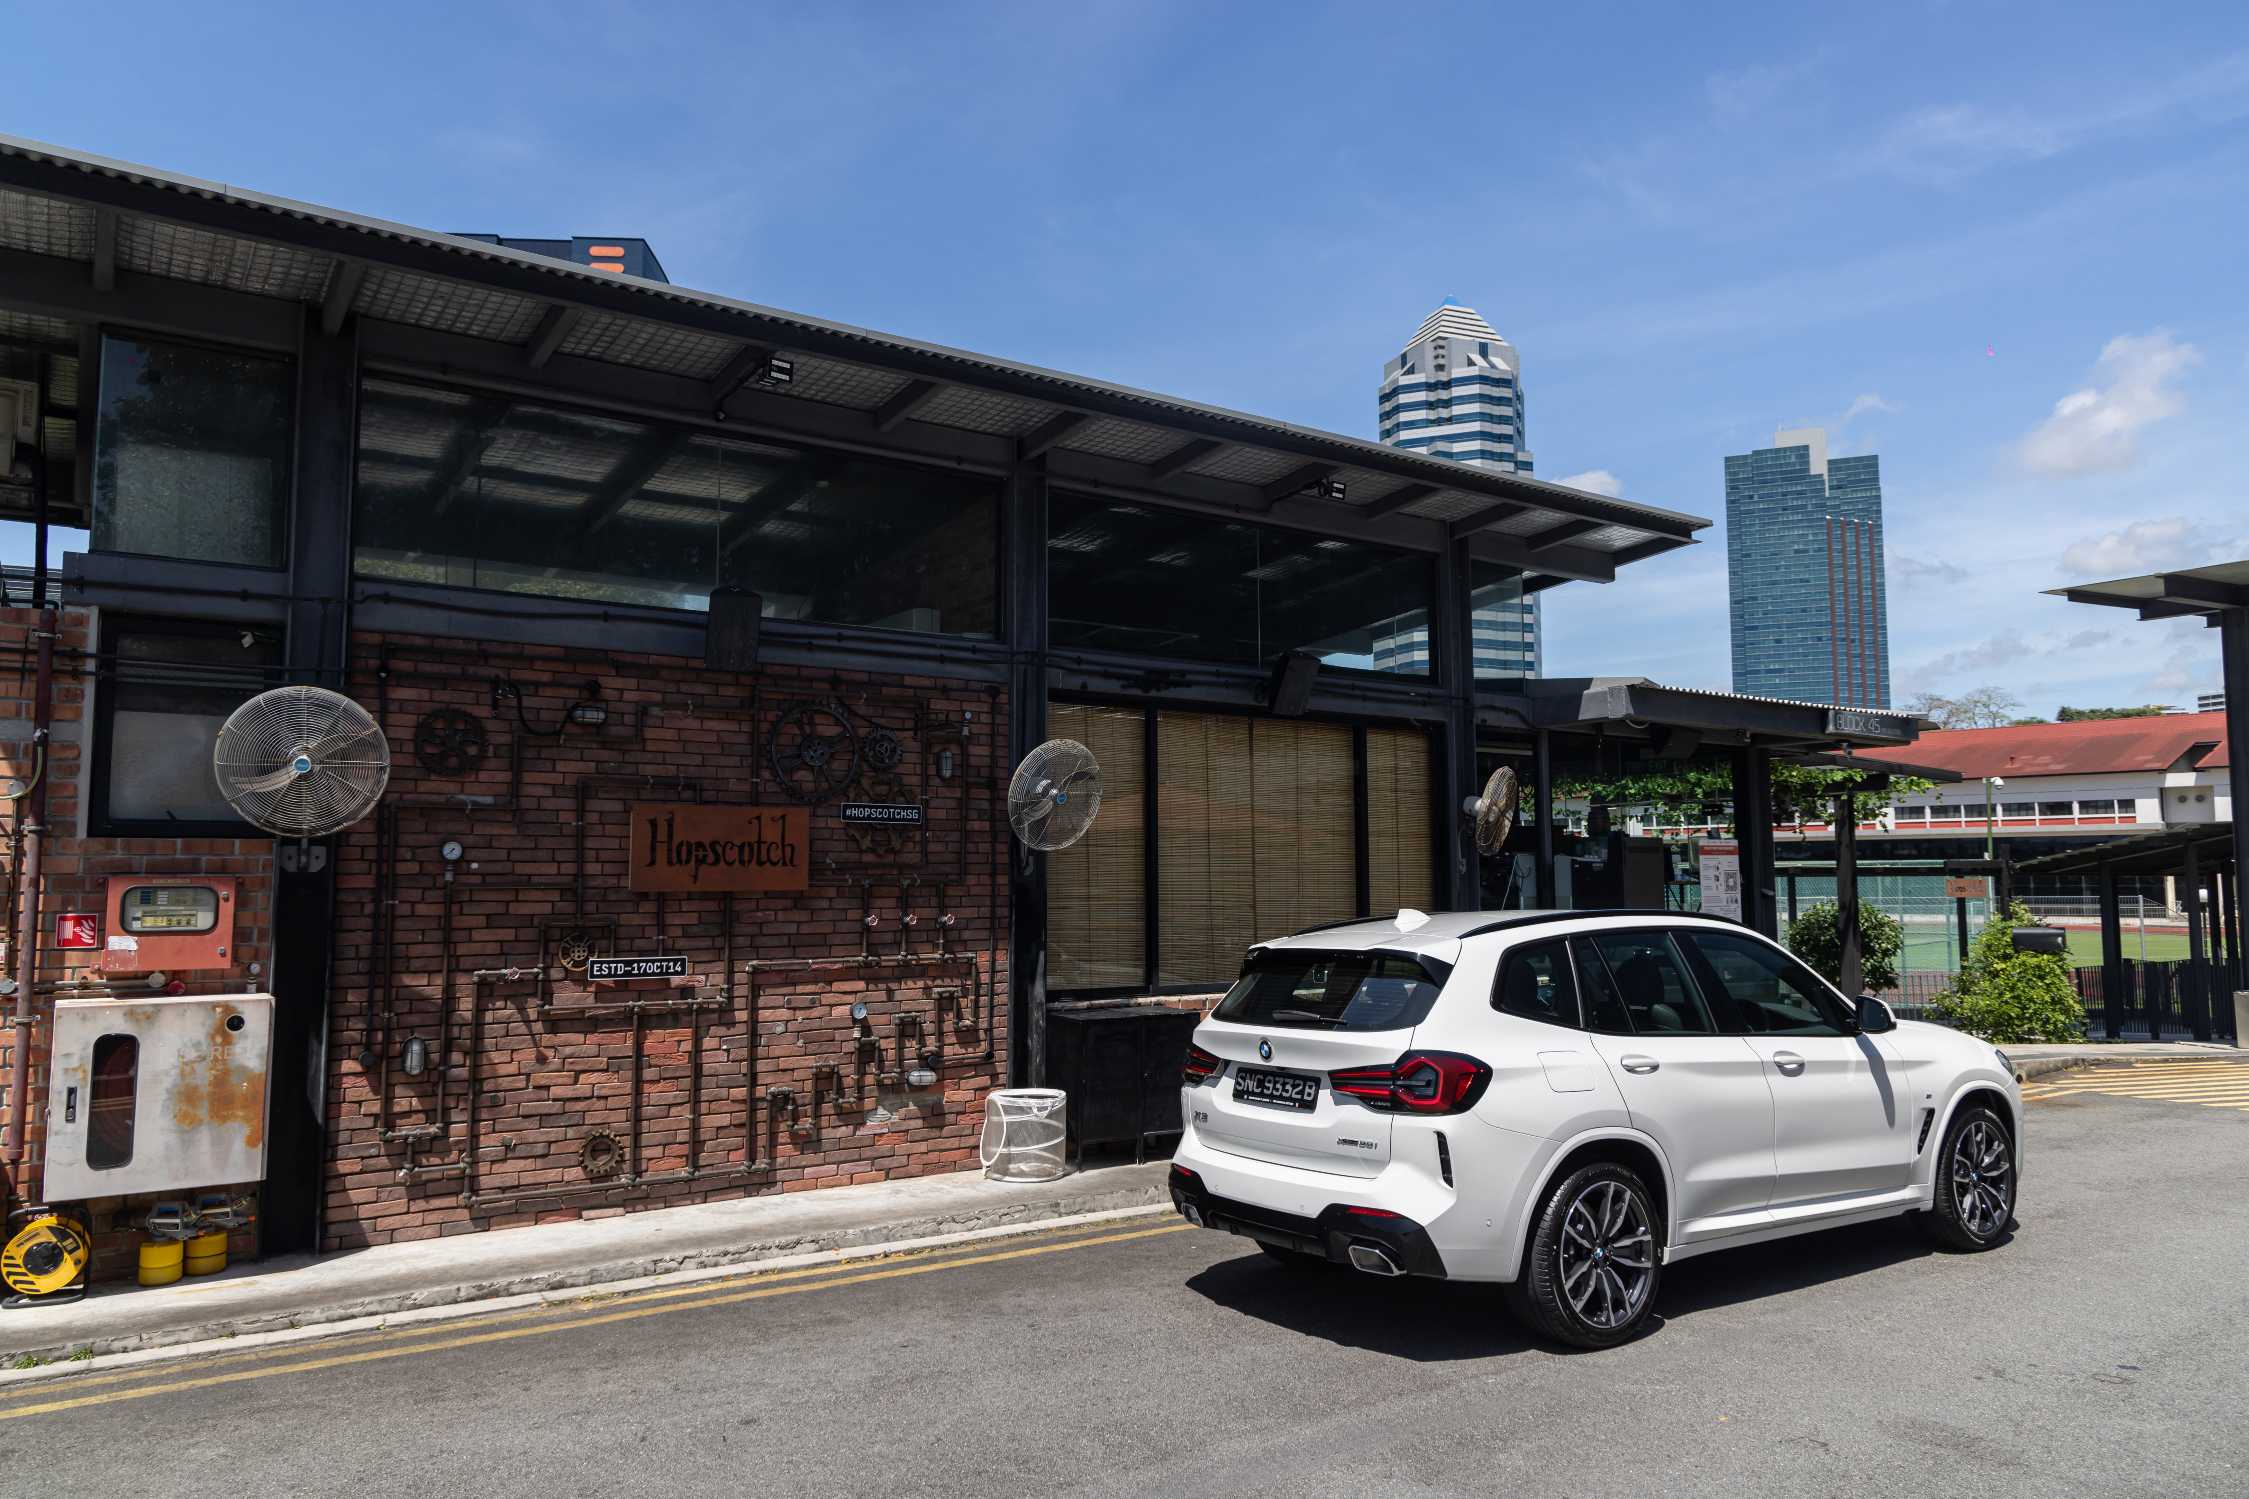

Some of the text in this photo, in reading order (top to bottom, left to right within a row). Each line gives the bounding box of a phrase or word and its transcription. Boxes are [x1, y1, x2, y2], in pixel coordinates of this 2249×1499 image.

[845, 807, 919, 819] #HOPSCOTCHSG
[645, 811, 796, 884] Hopscotch
[1235, 1072, 1316, 1101] SNC9332B
